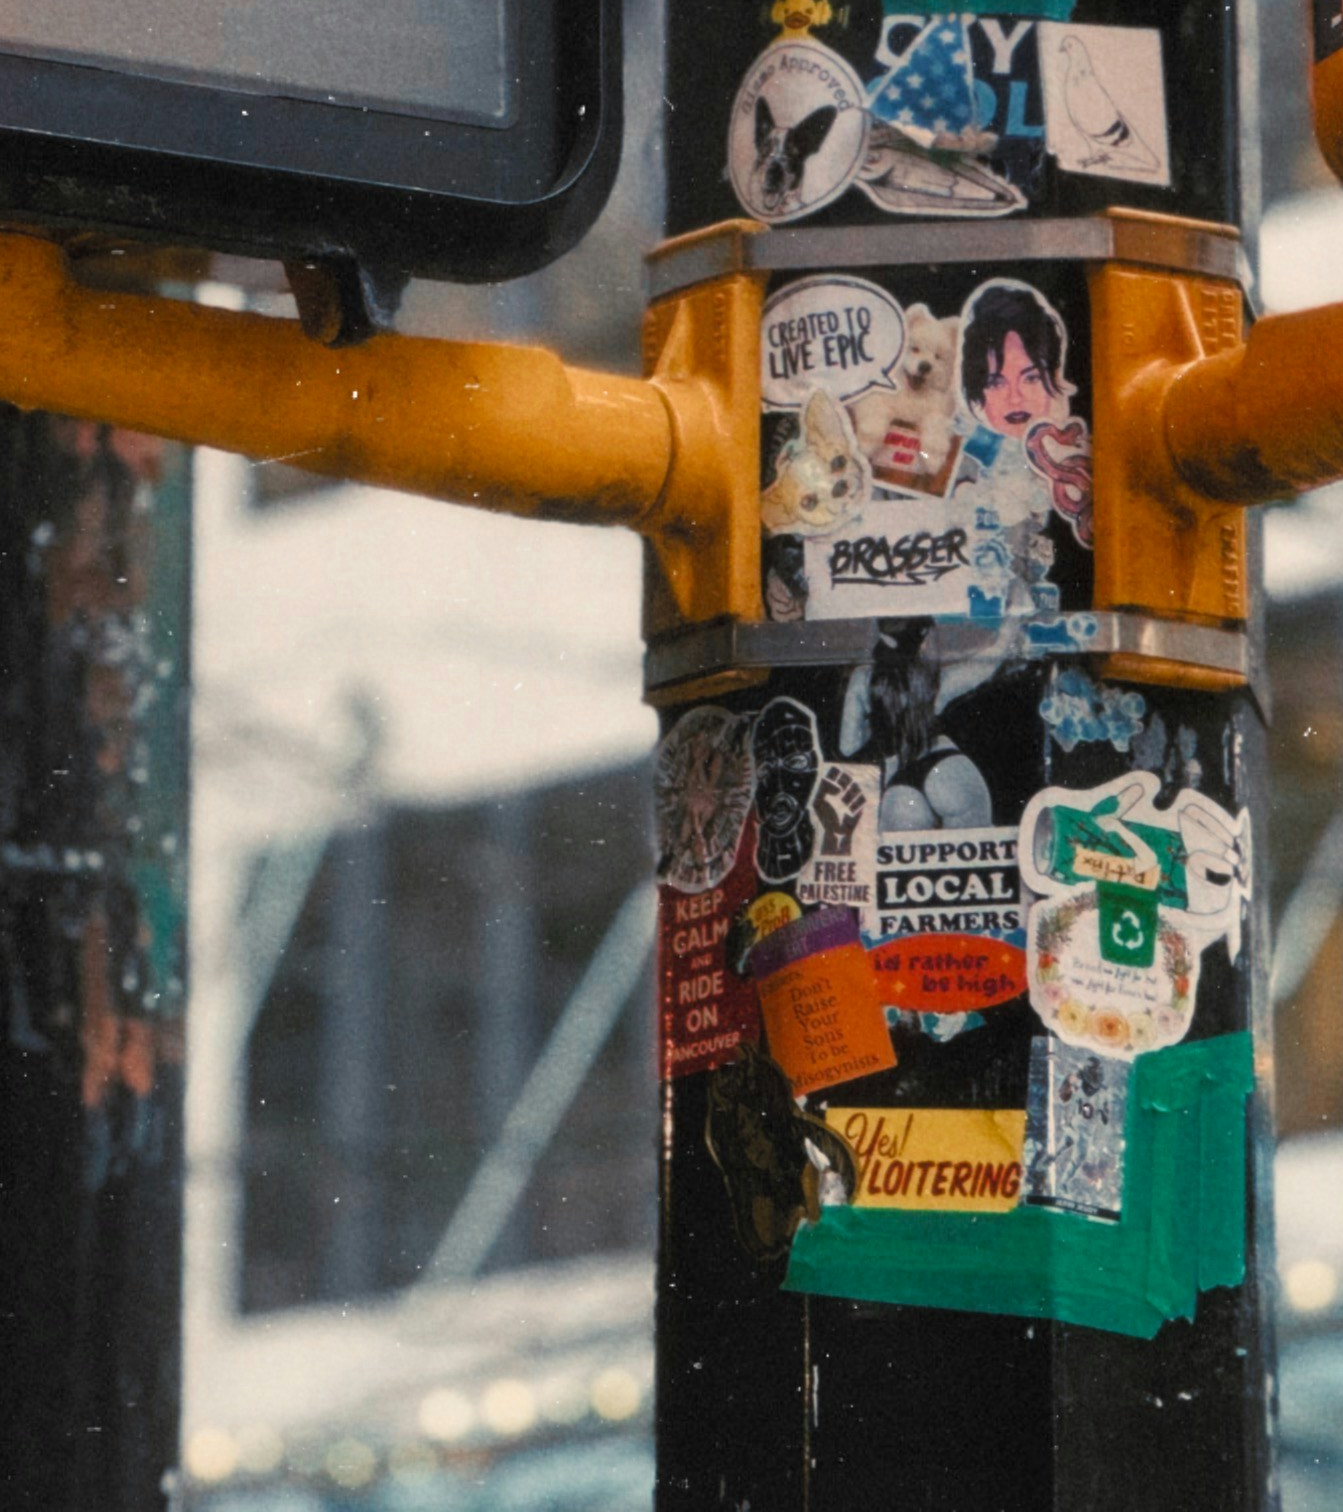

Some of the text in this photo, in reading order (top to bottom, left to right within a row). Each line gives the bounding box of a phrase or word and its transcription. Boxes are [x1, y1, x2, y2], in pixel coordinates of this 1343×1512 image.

[779, 54, 854, 113] Approved
[769, 308, 871, 348] CREATED TO
[770, 331, 874, 378] LIVE EPIC
[831, 528, 970, 577] BRASSER
[877, 840, 1017, 865] SUPPORT
[814, 861, 856, 882] FREE
[801, 883, 870, 903] PALESTINE
[885, 871, 1012, 904] LOCAL
[676, 890, 724, 918] KEEP
[879, 911, 1019, 934] FARMERS
[908, 953, 988, 971] rather
[679, 976, 724, 1004] RIDE
[921, 975, 1016, 995] be high
[686, 1008, 718, 1031] ON
[792, 994, 838, 1019] Raise
[798, 1010, 840, 1033] Your
[667, 1031, 740, 1064] ANCOUVER
[845, 1113, 909, 1155] Yes!
[869, 1161, 1022, 1199] LOITERING
